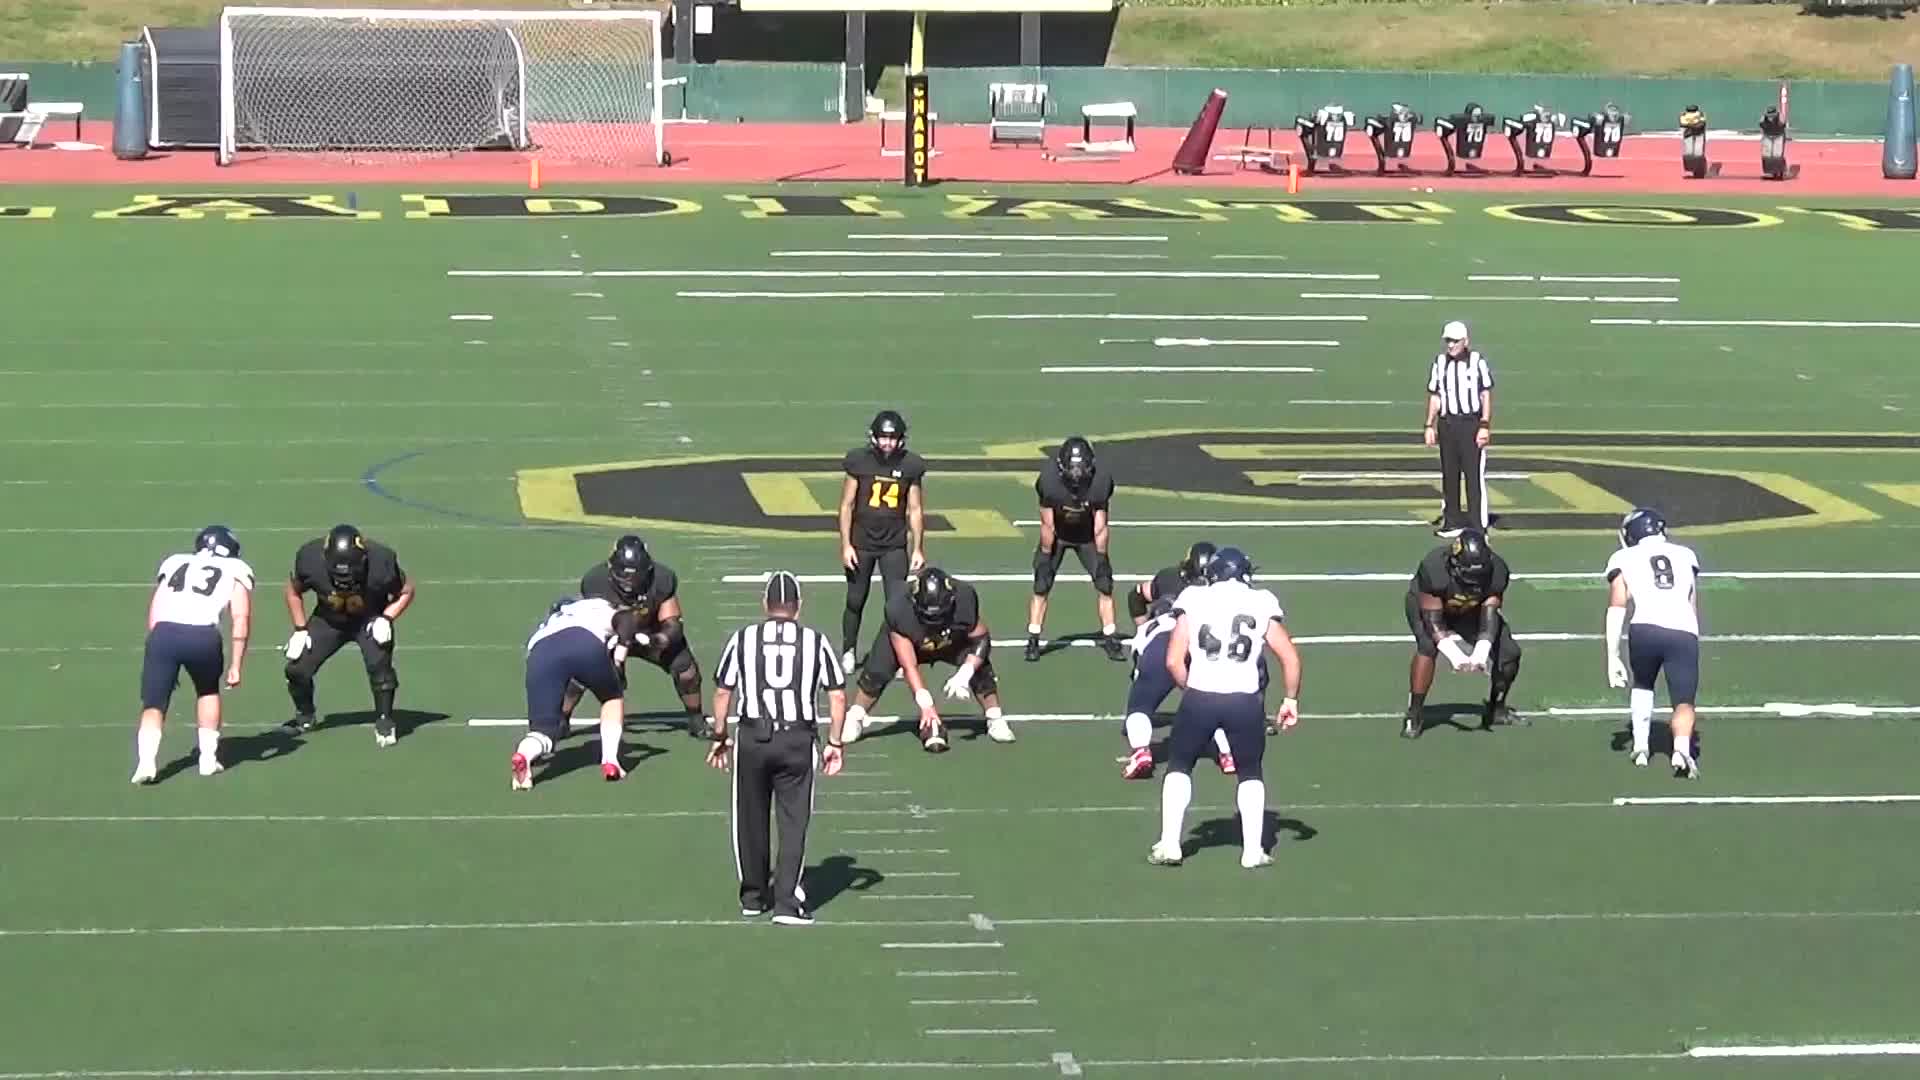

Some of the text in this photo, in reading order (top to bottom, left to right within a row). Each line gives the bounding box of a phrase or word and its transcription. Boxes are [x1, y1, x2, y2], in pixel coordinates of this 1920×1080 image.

[913, 83, 925, 184] CHABOT
[0, 191, 1920, 232] ADIATO
[868, 481, 899, 508] 14
[168, 562, 222, 597] 43
[762, 644, 797, 688] U
